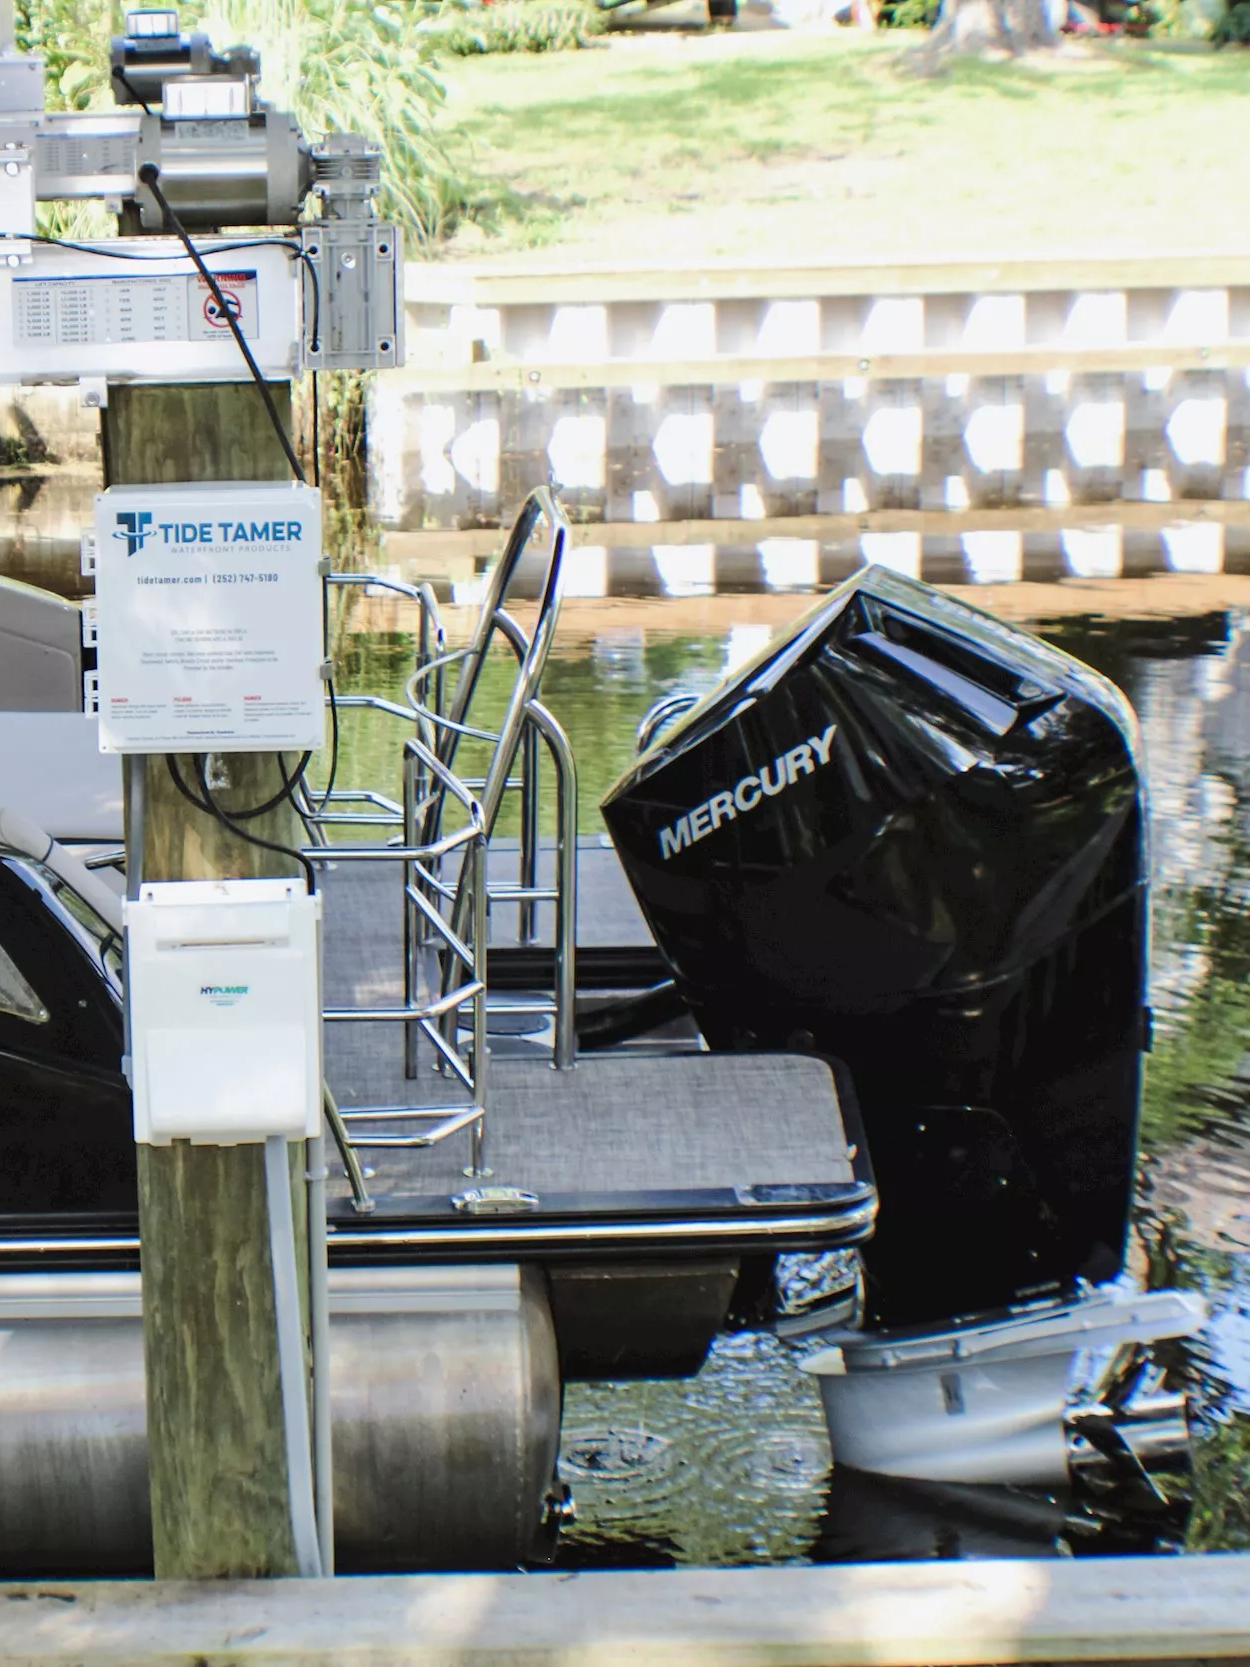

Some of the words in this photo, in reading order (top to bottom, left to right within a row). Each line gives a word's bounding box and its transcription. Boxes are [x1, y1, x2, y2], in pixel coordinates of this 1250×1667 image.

[196, 273, 246, 282] WRNING
[158, 522, 213, 544] TIDE
[218, 521, 302, 542] TAMER
[171, 546, 235, 554] WATERFRONT
[137, 575, 202, 584] tidetamer.com
[213, 574, 237, 584] (252)
[239, 573, 279, 583] 747-5180
[659, 724, 838, 860] MERCURY
